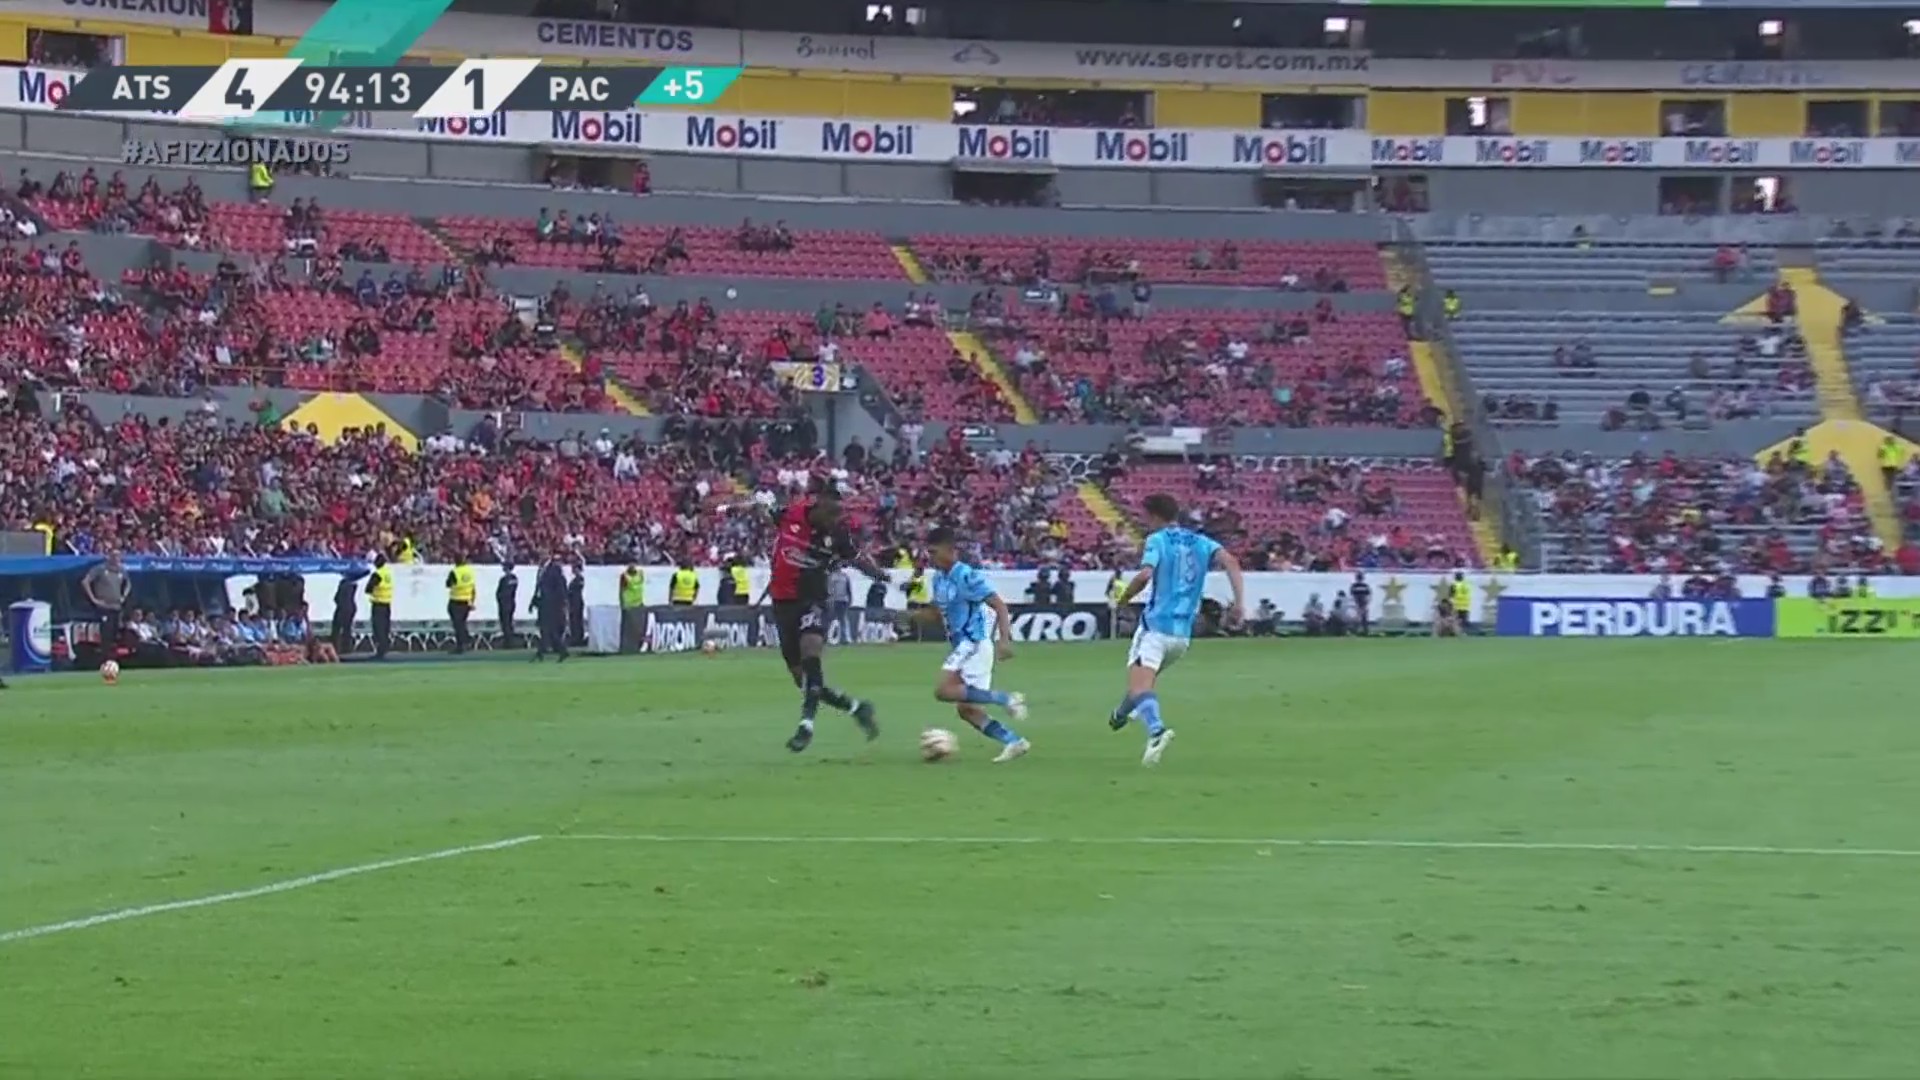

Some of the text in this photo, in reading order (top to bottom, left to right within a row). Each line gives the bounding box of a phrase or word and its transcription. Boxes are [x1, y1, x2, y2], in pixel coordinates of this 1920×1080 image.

[539, 22, 693, 51] CEMENTOS
[1076, 49, 1369, 71] www.serrot.com.mx
[552, 111, 642, 143] Mobil
[687, 116, 777, 149] Mobil
[822, 122, 913, 154] Mobil
[958, 127, 1049, 158] Mobil
[1096, 131, 1188, 161] Mobil
[1233, 134, 1327, 163] Mobil
[640, 612, 696, 653] AKRON
[1531, 602, 1738, 636] PERDURA
